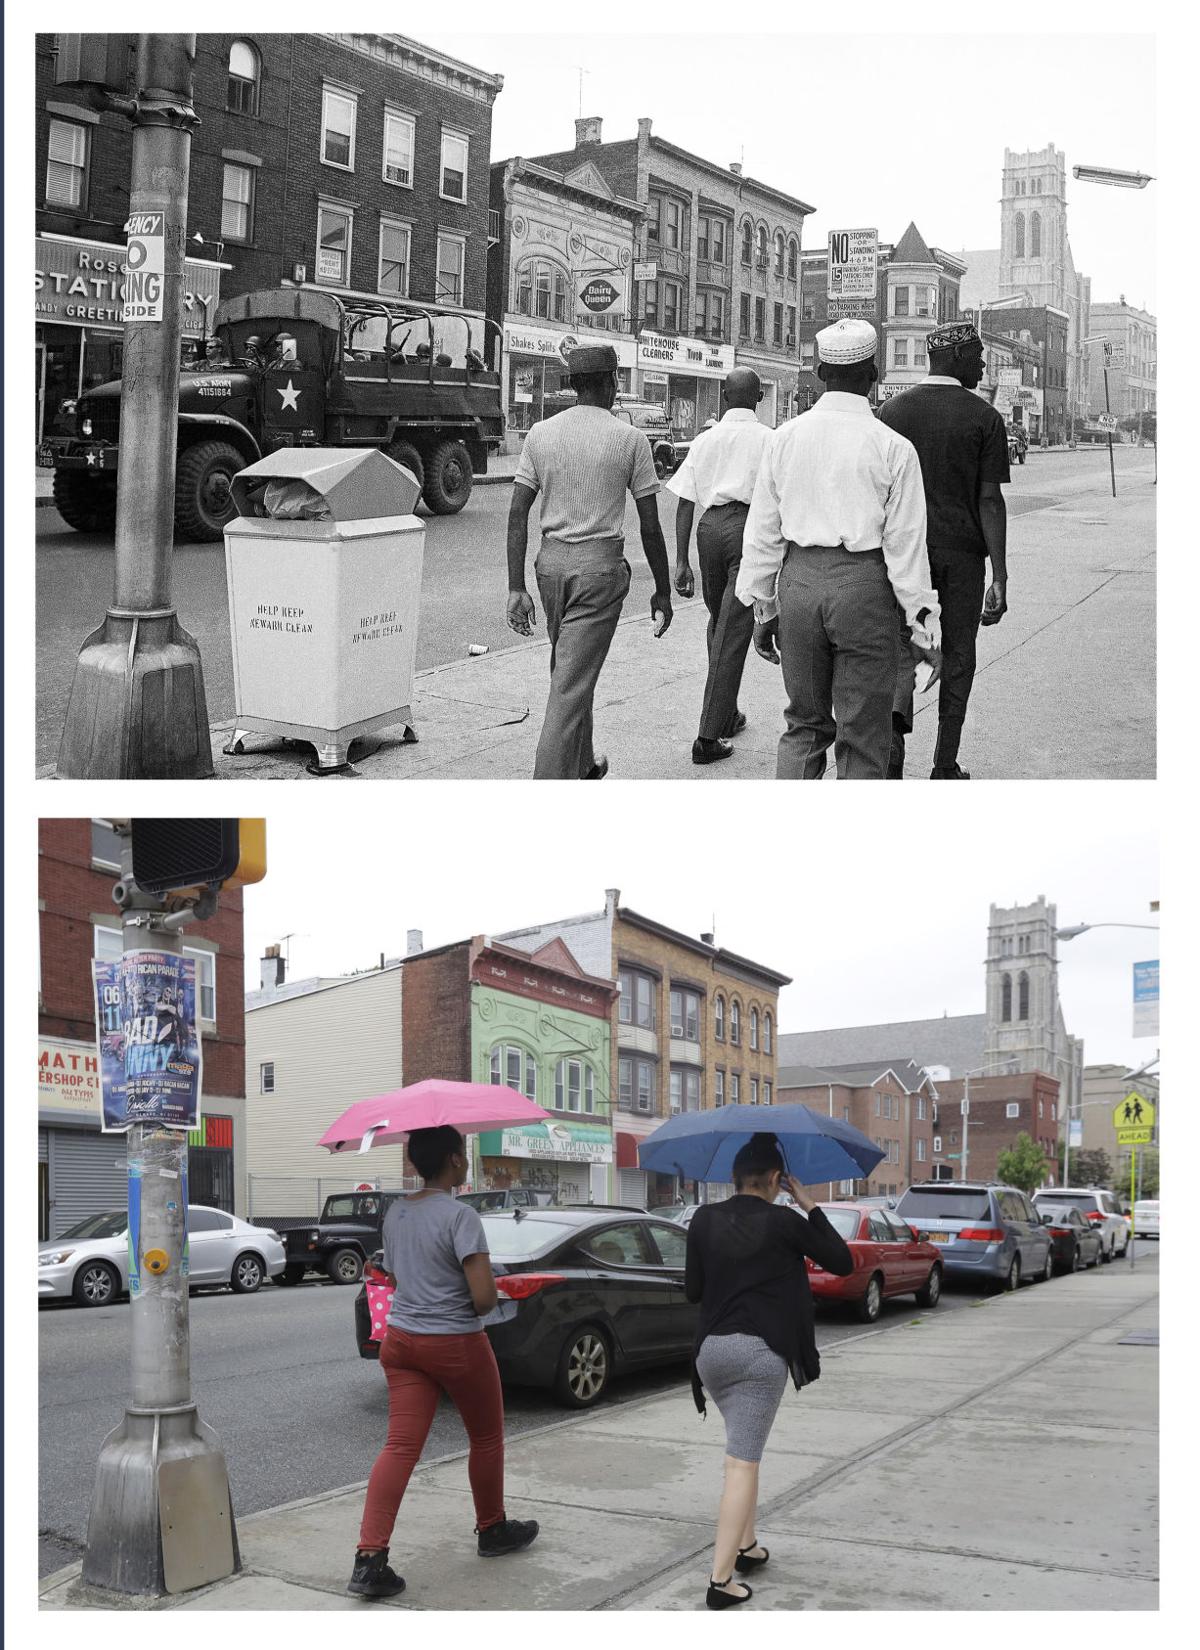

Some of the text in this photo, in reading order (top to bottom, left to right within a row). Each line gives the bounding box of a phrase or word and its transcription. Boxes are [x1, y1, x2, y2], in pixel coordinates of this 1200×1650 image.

[831, 232, 875, 264] NO STOPPING
[849, 246, 875, 255] STANDING
[832, 267, 842, 281] 15
[588, 285, 611, 295] Dairy
[585, 295, 611, 305] Queen
[35, 302, 58, 313] ANDY
[125, 306, 156, 317] SIDE
[511, 336, 534, 350] Shakes
[538, 340, 556, 352] Splits
[642, 347, 674, 361] CLEANERS
[257, 604, 304, 618] HELP KEEP
[250, 618, 313, 633] NEWARK CLEAN
[360, 611, 397, 628] HELP KEEP
[157, 964, 180, 977] PARADE
[104, 985, 120, 1005] 06
[104, 1006, 120, 1031] 11
[1119, 1131, 1149, 1140] AHEAD
[508, 1136, 523, 1147] MR.
[527, 1138, 555, 1150] GREEN
[560, 1141, 606, 1153] APPLIANCES
